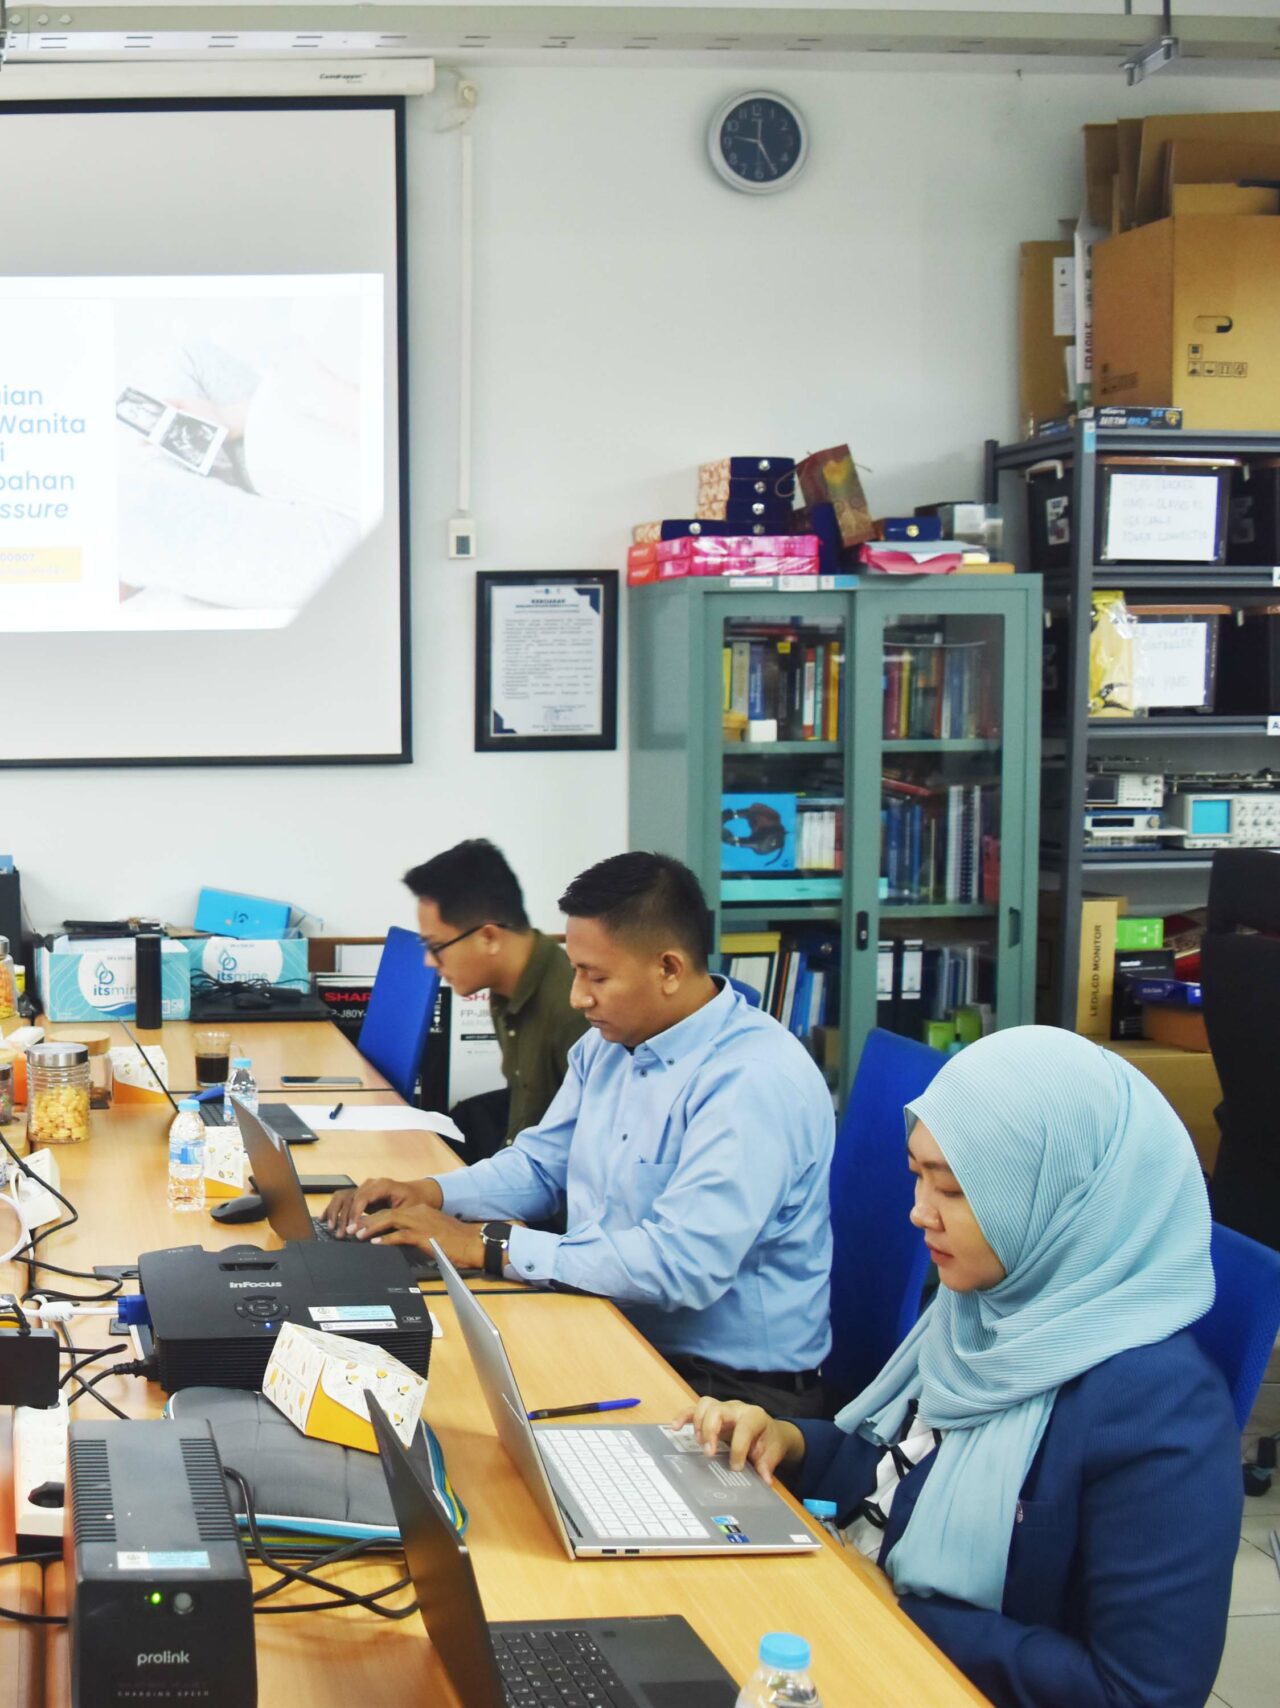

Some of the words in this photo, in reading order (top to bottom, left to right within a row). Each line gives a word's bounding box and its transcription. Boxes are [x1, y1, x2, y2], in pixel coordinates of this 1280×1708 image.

[1092, 924, 1102, 971] MONITOR
[93, 984, 137, 996] itsmin
[324, 992, 372, 1001] SHAR
